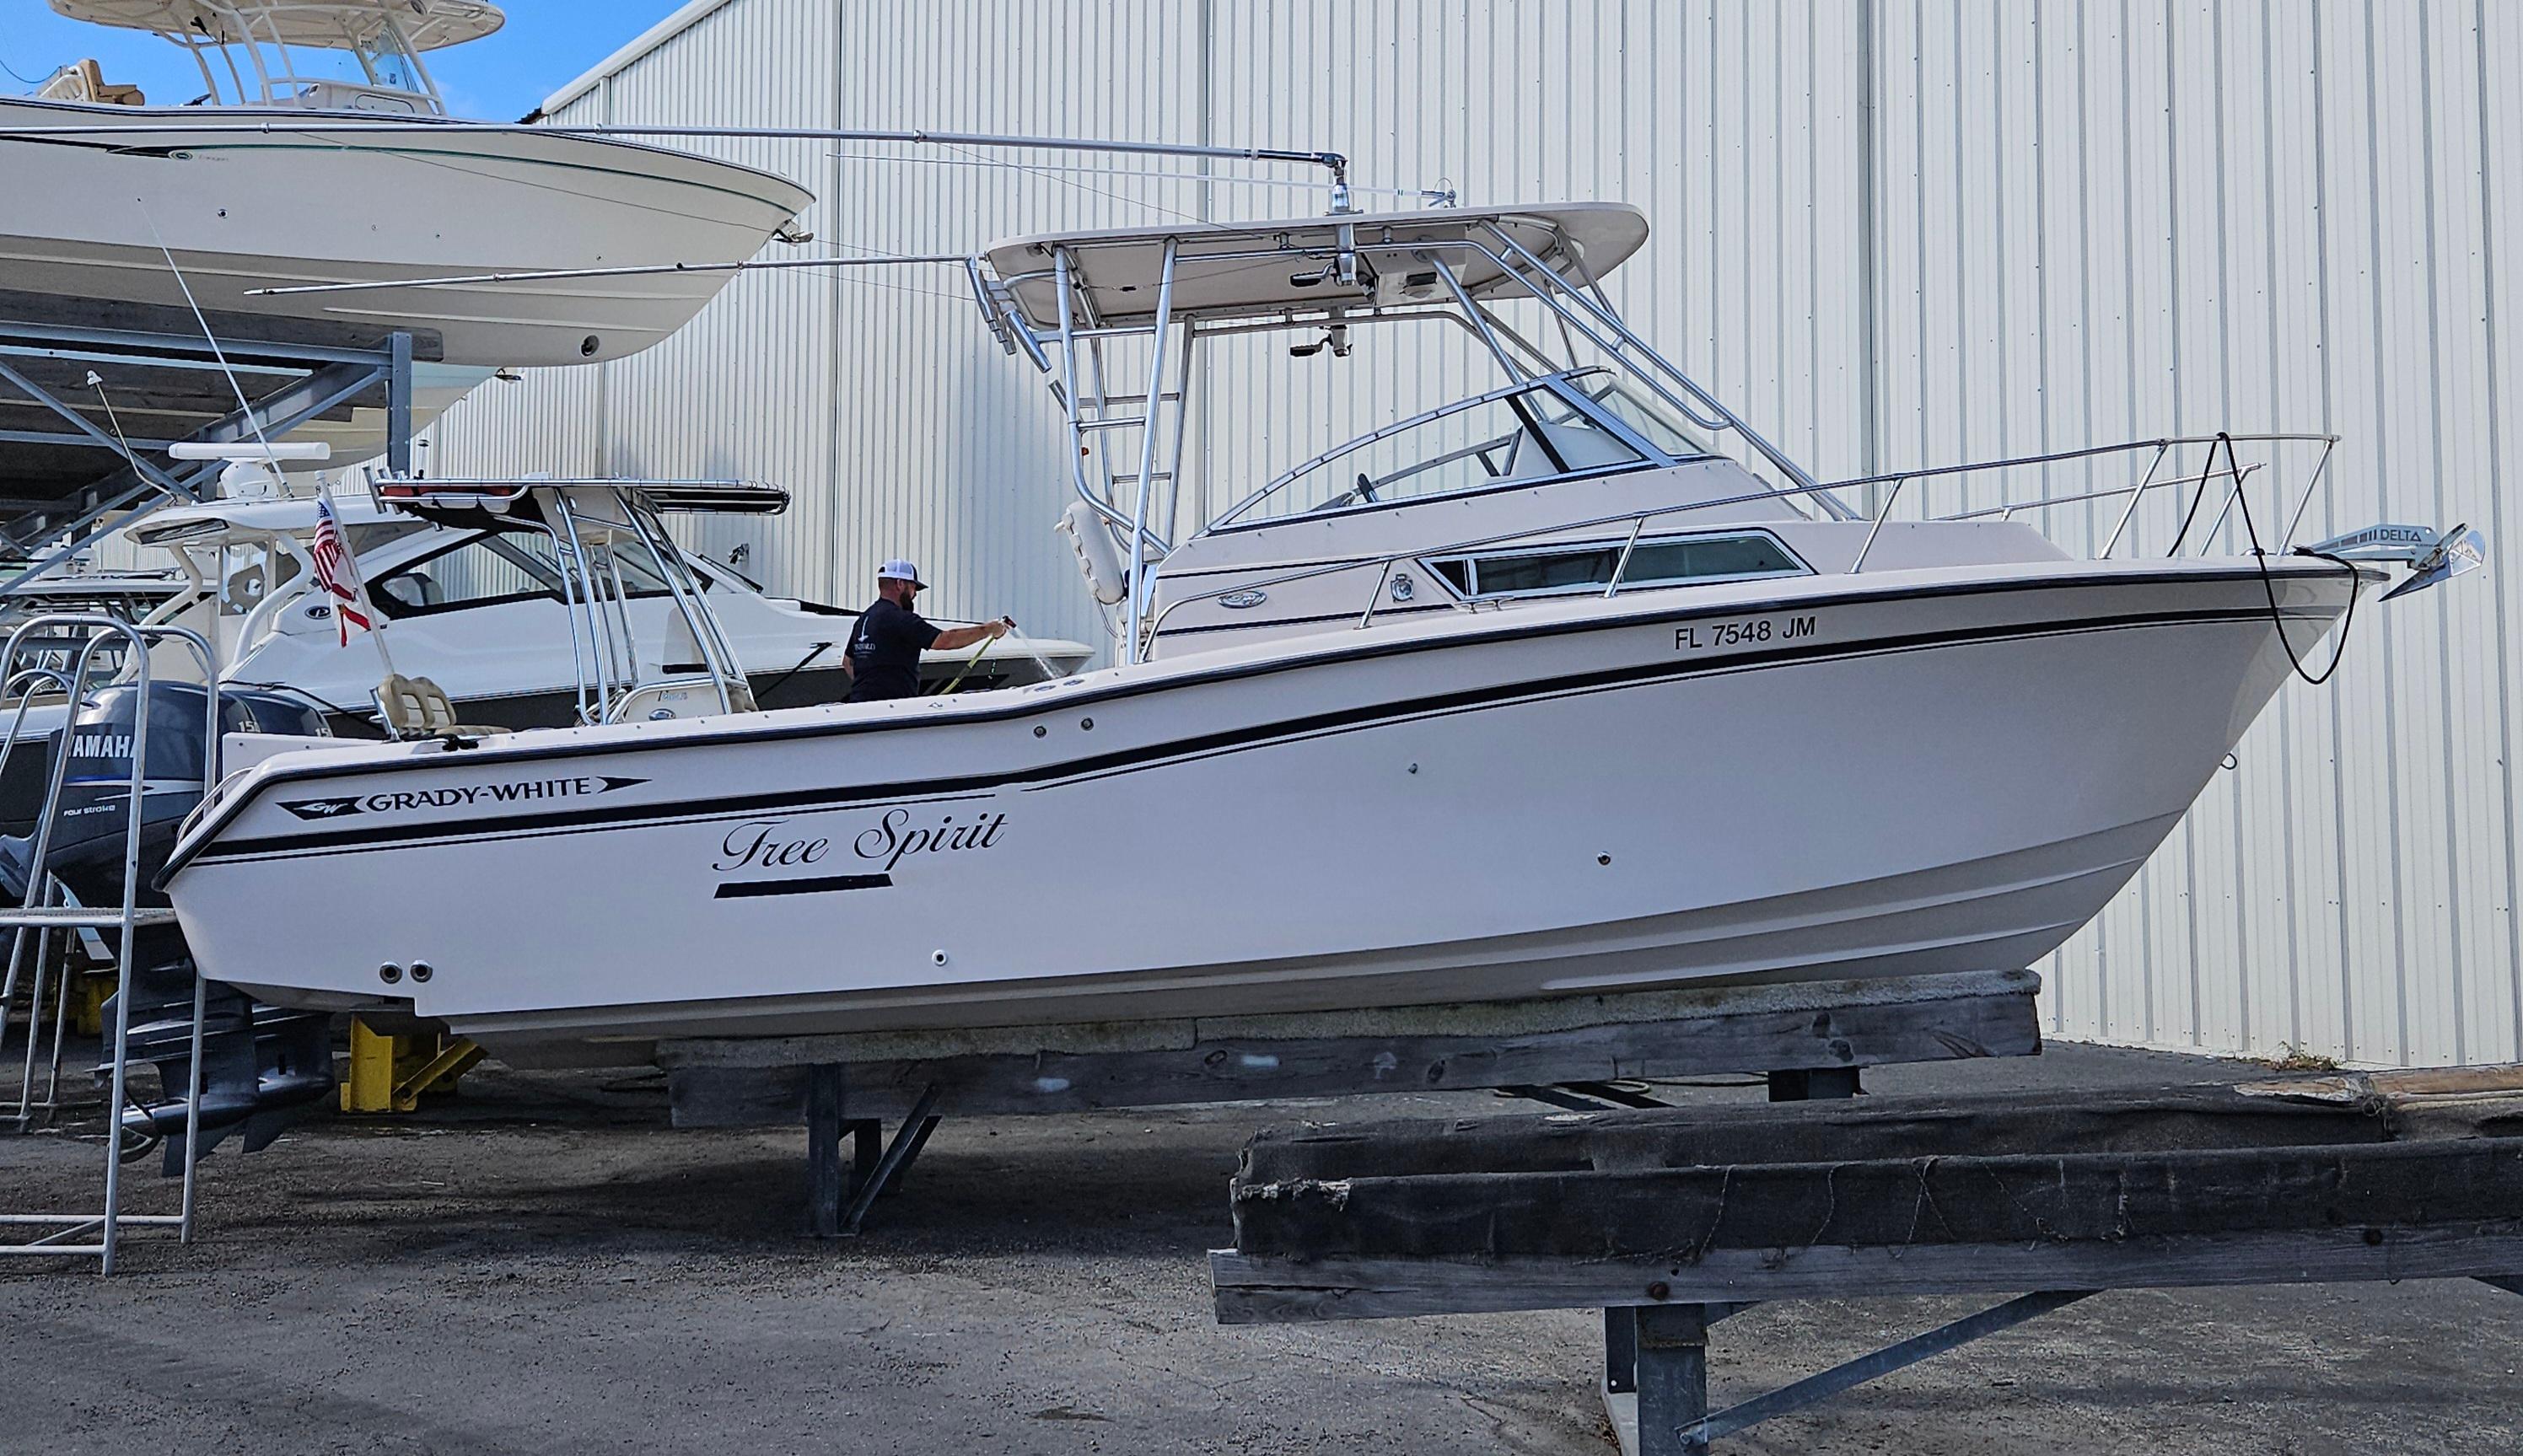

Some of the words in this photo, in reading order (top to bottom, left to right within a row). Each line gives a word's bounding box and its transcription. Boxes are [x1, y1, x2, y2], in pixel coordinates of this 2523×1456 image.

[2380, 529, 2422, 542] DELTA
[1675, 627, 1703, 650] FL
[1712, 620, 1772, 647] 7548
[1782, 615, 1816, 639] JM
[365, 776, 590, 812] GRADY-WHITE
[712, 819, 830, 872] Free
[853, 808, 1008, 872] Spirit
